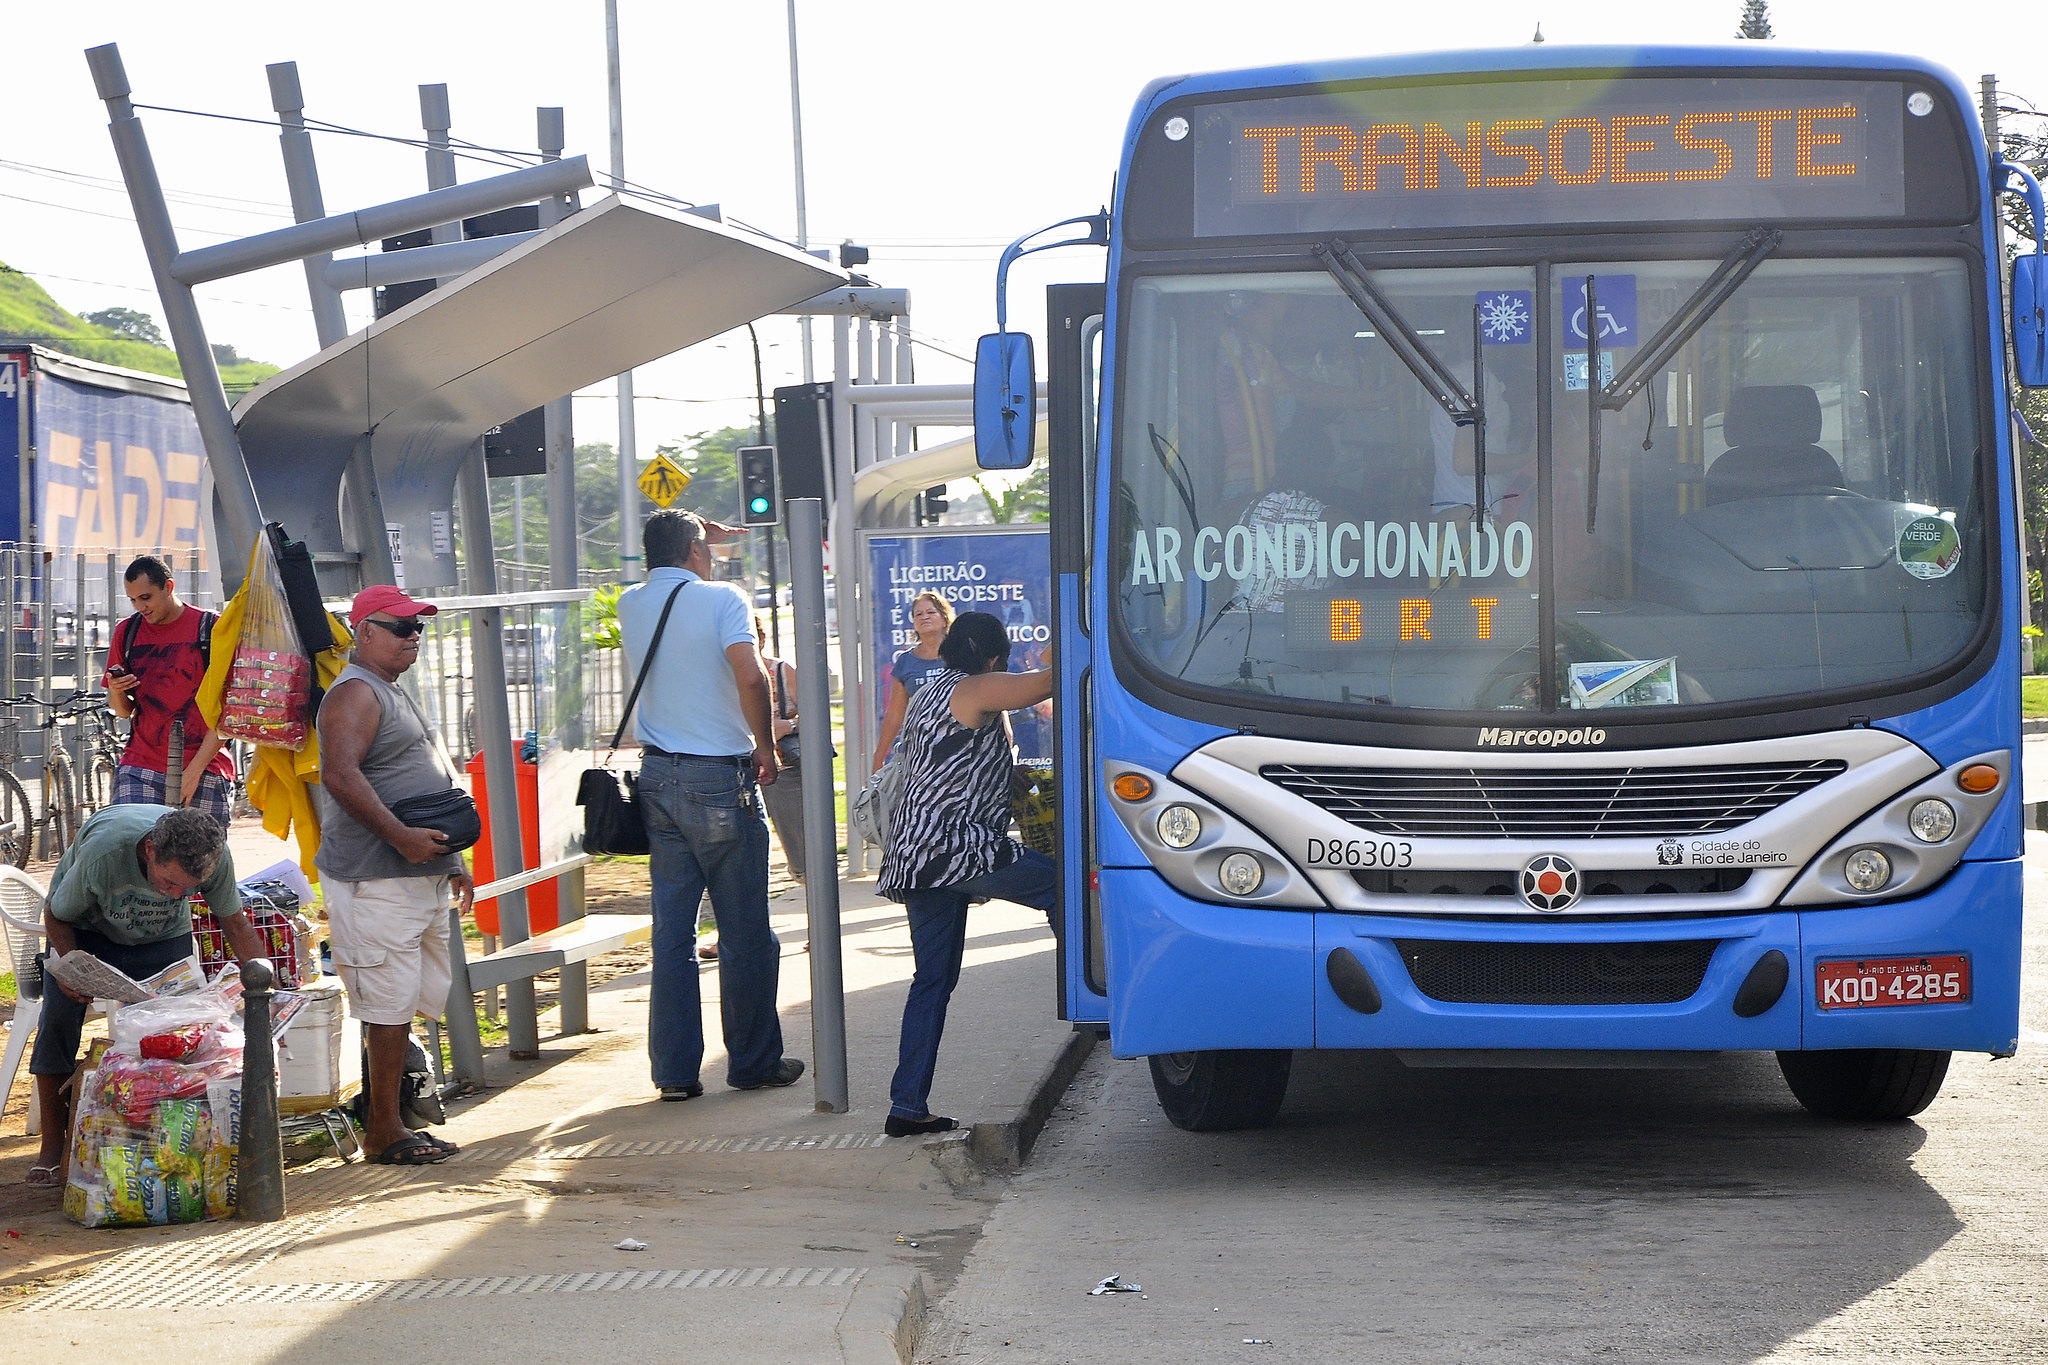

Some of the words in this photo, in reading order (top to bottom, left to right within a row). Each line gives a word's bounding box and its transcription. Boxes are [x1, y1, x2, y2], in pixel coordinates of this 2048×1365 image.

[1243, 106, 1857, 194] TRANSOESTE
[1567, 356, 1576, 388] 2012
[44, 430, 208, 571] FADE
[1905, 532, 1941, 541] VERDE
[1913, 523, 1935, 531] SELO
[1131, 526, 1185, 587] AR
[1193, 520, 1533, 583] CONDICIONADO
[889, 561, 986, 584] LIGEIRÃO
[889, 584, 1024, 604] TRSOESTE
[1330, 599, 1362, 642] B
[1400, 598, 1432, 641] R
[1471, 598, 1498, 640] T
[1477, 726, 1607, 748] Marcopolo
[1307, 838, 1413, 869] D86303
[1691, 840, 1740, 852] Cidade
[1743, 840, 1760, 851] do
[1692, 853, 1714, 865] Rio
[1716, 853, 1734, 864] de
[1738, 851, 1787, 864] Janeiro
[1887, 966, 1897, 974] DE
[1900, 964, 1933, 973] JANEIRO
